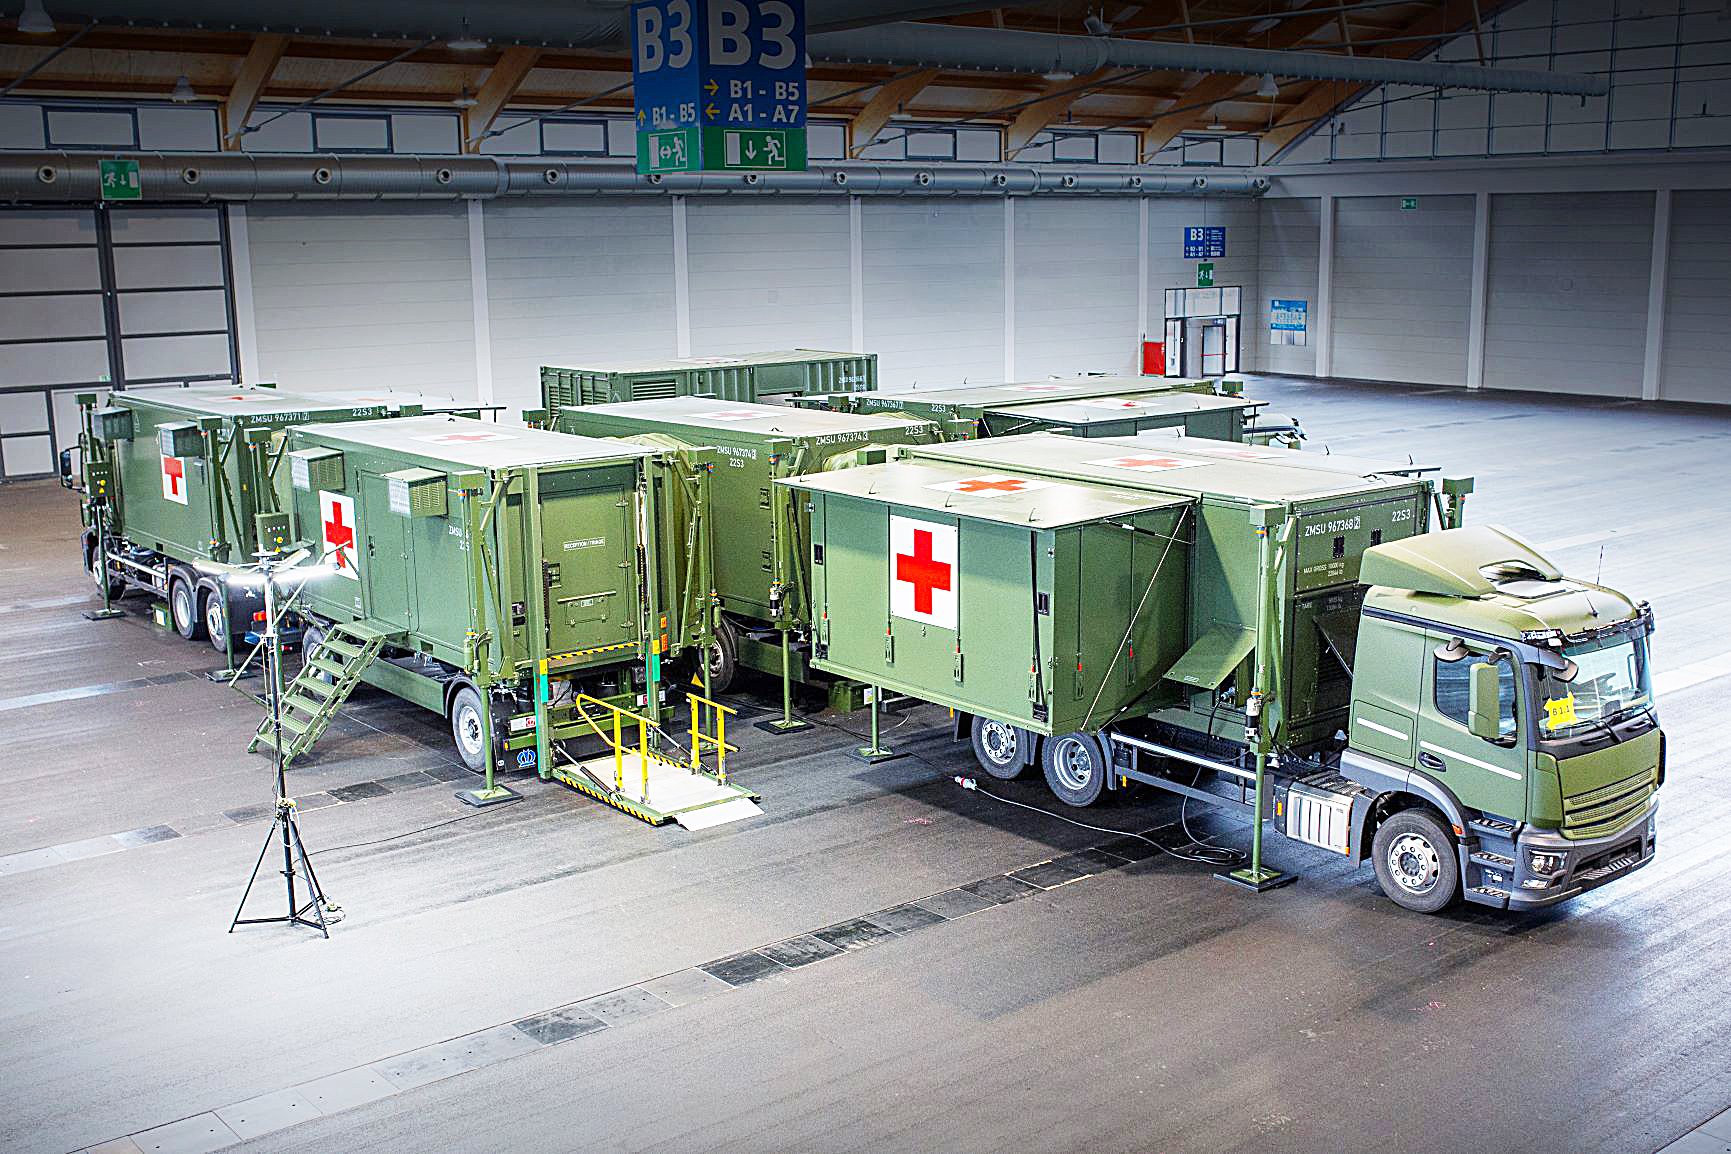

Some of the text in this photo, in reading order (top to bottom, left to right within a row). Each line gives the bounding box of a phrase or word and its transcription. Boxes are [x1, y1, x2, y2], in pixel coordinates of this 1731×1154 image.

[637, 0, 693, 73] B3
[708, 0, 796, 70] B3
[729, 80, 753, 98] B1
[775, 81, 799, 101] B5
[652, 106, 667, 125] B1
[679, 102, 696, 123] B5
[728, 103, 752, 122] A1
[772, 105, 799, 123] A7
[1190, 228, 1204, 240] B3
[866, 399, 880, 407] ZMSU
[251, 415, 272, 423] ZMSU
[816, 435, 836, 445] ZMSU
[717, 446, 731, 455] ZMSU
[1392, 508, 1411, 522] 22S3
[1305, 523, 1326, 537] ZMSU
